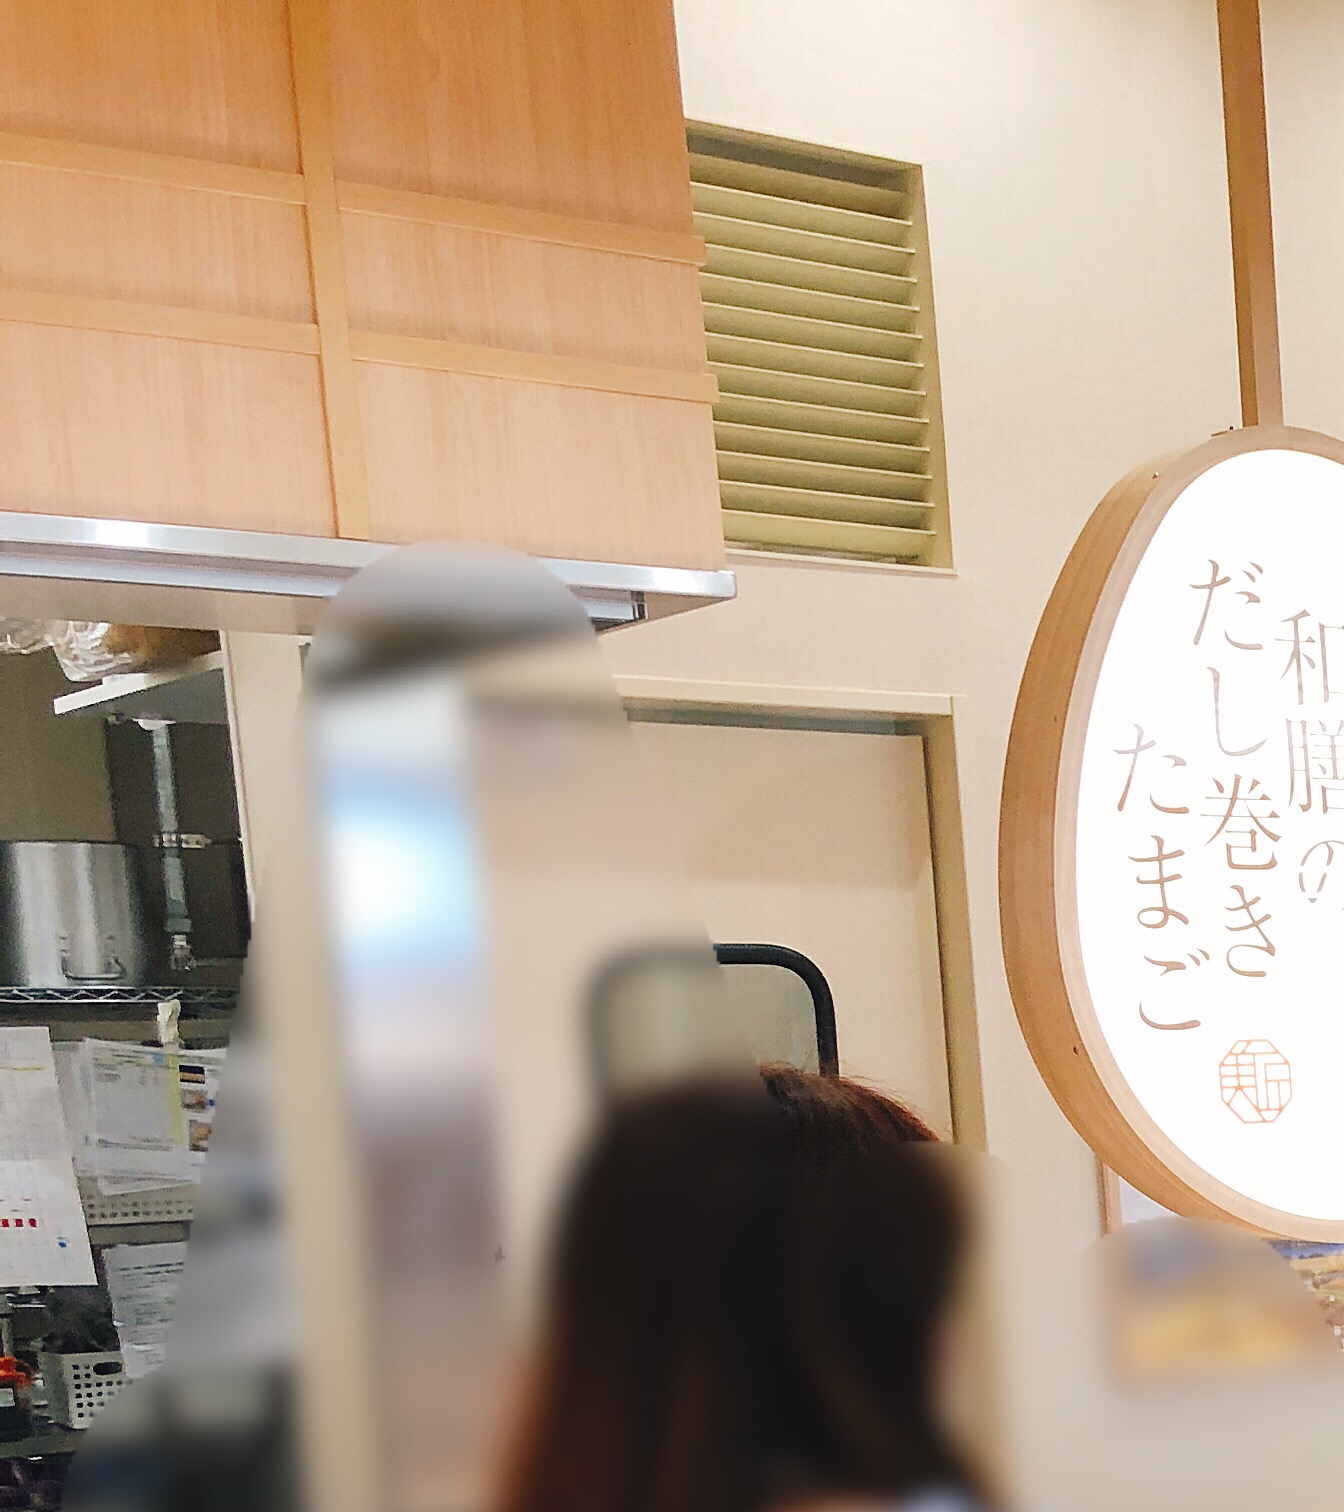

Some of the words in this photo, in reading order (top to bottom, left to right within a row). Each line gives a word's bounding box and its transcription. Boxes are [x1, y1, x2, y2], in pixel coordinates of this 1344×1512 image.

[1113, 723, 1211, 1031] たまご
[1189, 559, 1283, 978] だし巻き
